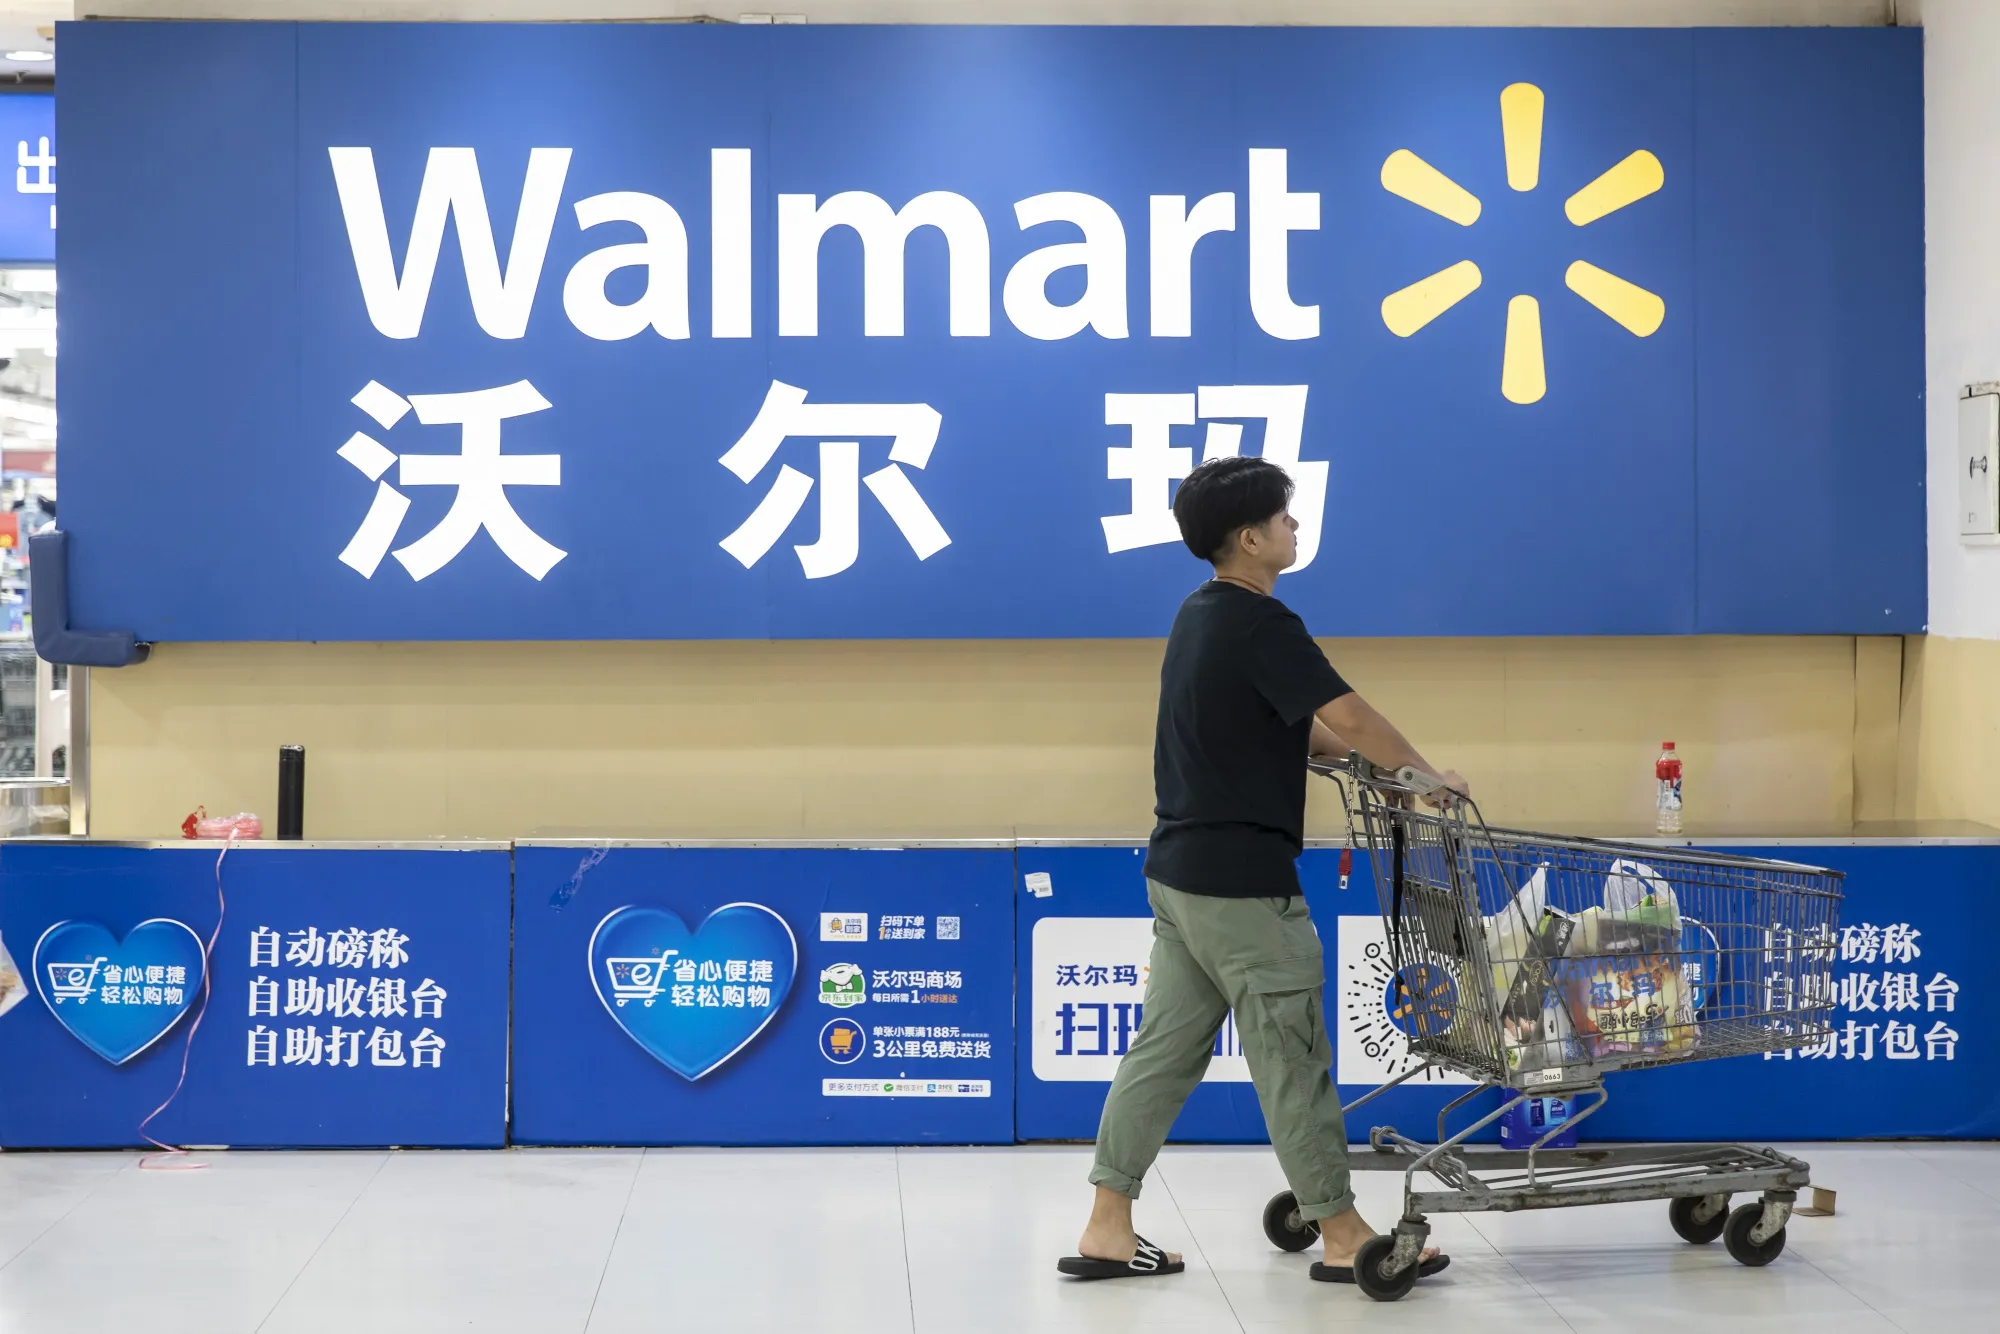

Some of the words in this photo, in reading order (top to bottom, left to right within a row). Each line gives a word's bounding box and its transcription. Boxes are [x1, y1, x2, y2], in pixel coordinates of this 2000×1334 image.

[328, 147, 1320, 341] Walmart
[336, 379, 1329, 582] 沃尔玛
[881, 915, 925, 927] 扫码下单
[249, 926, 409, 968] 自动磅称
[1764, 923, 1921, 964] 自动磅称
[102, 965, 186, 984] 省心便捷
[674, 959, 773, 983] 省心便捷
[873, 970, 962, 988] 沃尔玛商场
[1058, 965, 1138, 986] 沃尔玛
[101, 986, 184, 1005] 轻松购物
[249, 976, 448, 1018] 自助收银台
[672, 984, 771, 1008] 轻松购物
[1764, 971, 1959, 1012] 自助收银台
[873, 1026, 960, 1038] 单张小票满188元
[248, 1025, 446, 1067] 自助打包台
[873, 1040, 992, 1059] 3公里免费送货
[828, 1082, 879, 1092] 更多支付方式
[1545, 1073, 1561, 1081] 0663
